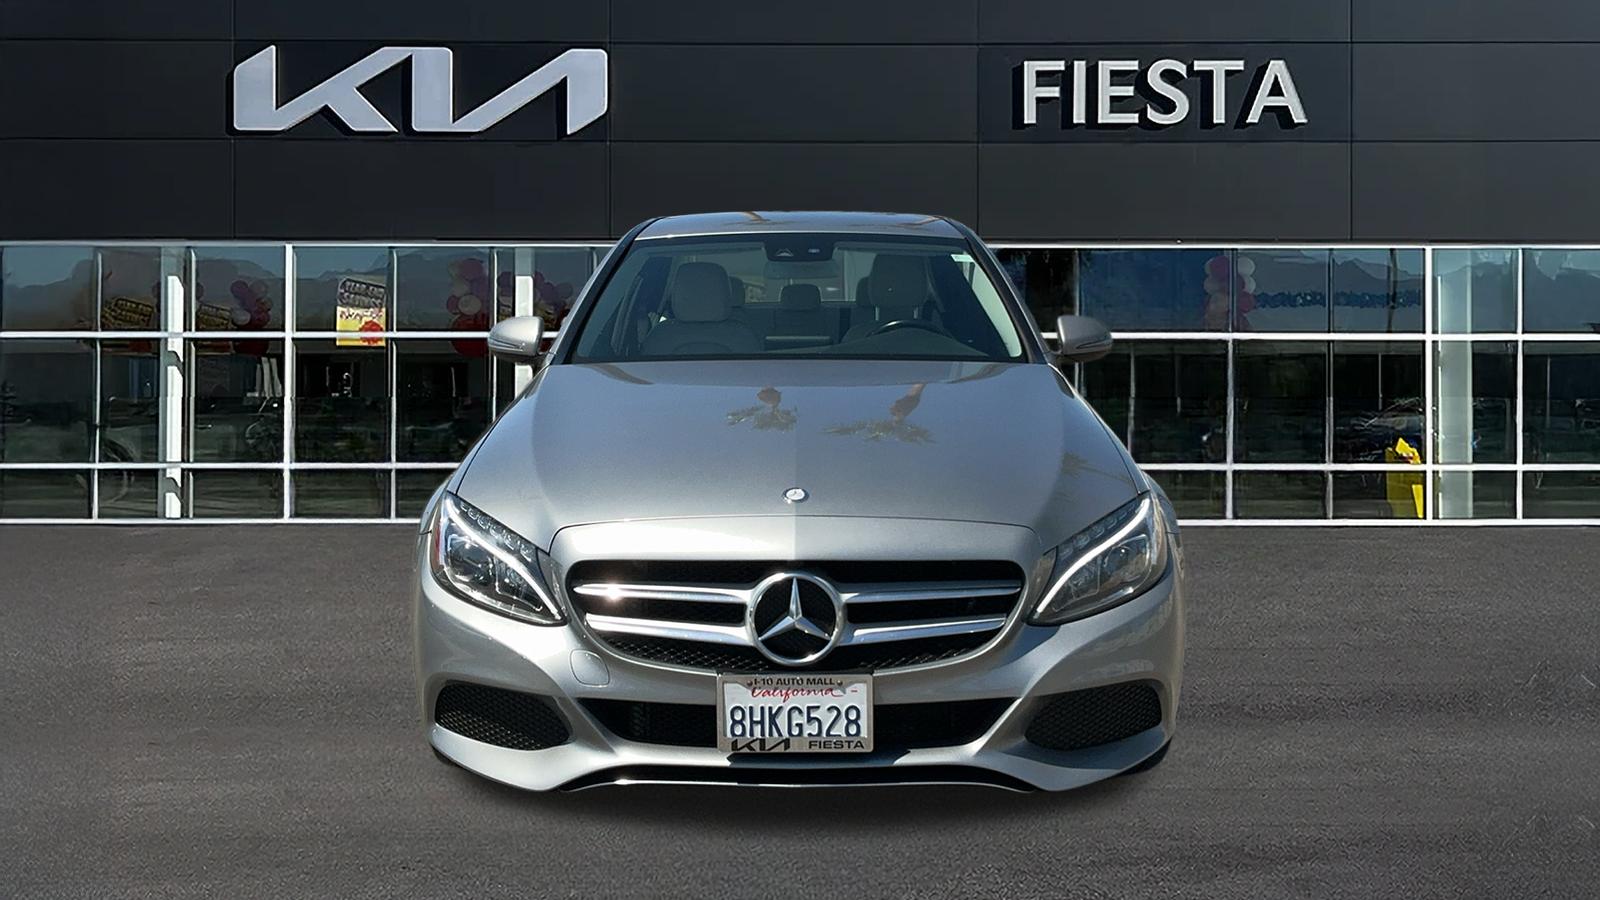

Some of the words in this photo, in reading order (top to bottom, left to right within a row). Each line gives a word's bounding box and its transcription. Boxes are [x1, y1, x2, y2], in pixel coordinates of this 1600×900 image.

[233, 44, 608, 135] KIA
[1022, 58, 1309, 125] FIESTA
[753, 677, 773, 686] I-10
[776, 677, 804, 686] AUTO
[806, 677, 835, 686] MALL
[751, 686, 844, 703] California
[730, 705, 861, 737] 8HKG528
[808, 740, 864, 750] FIESTA
